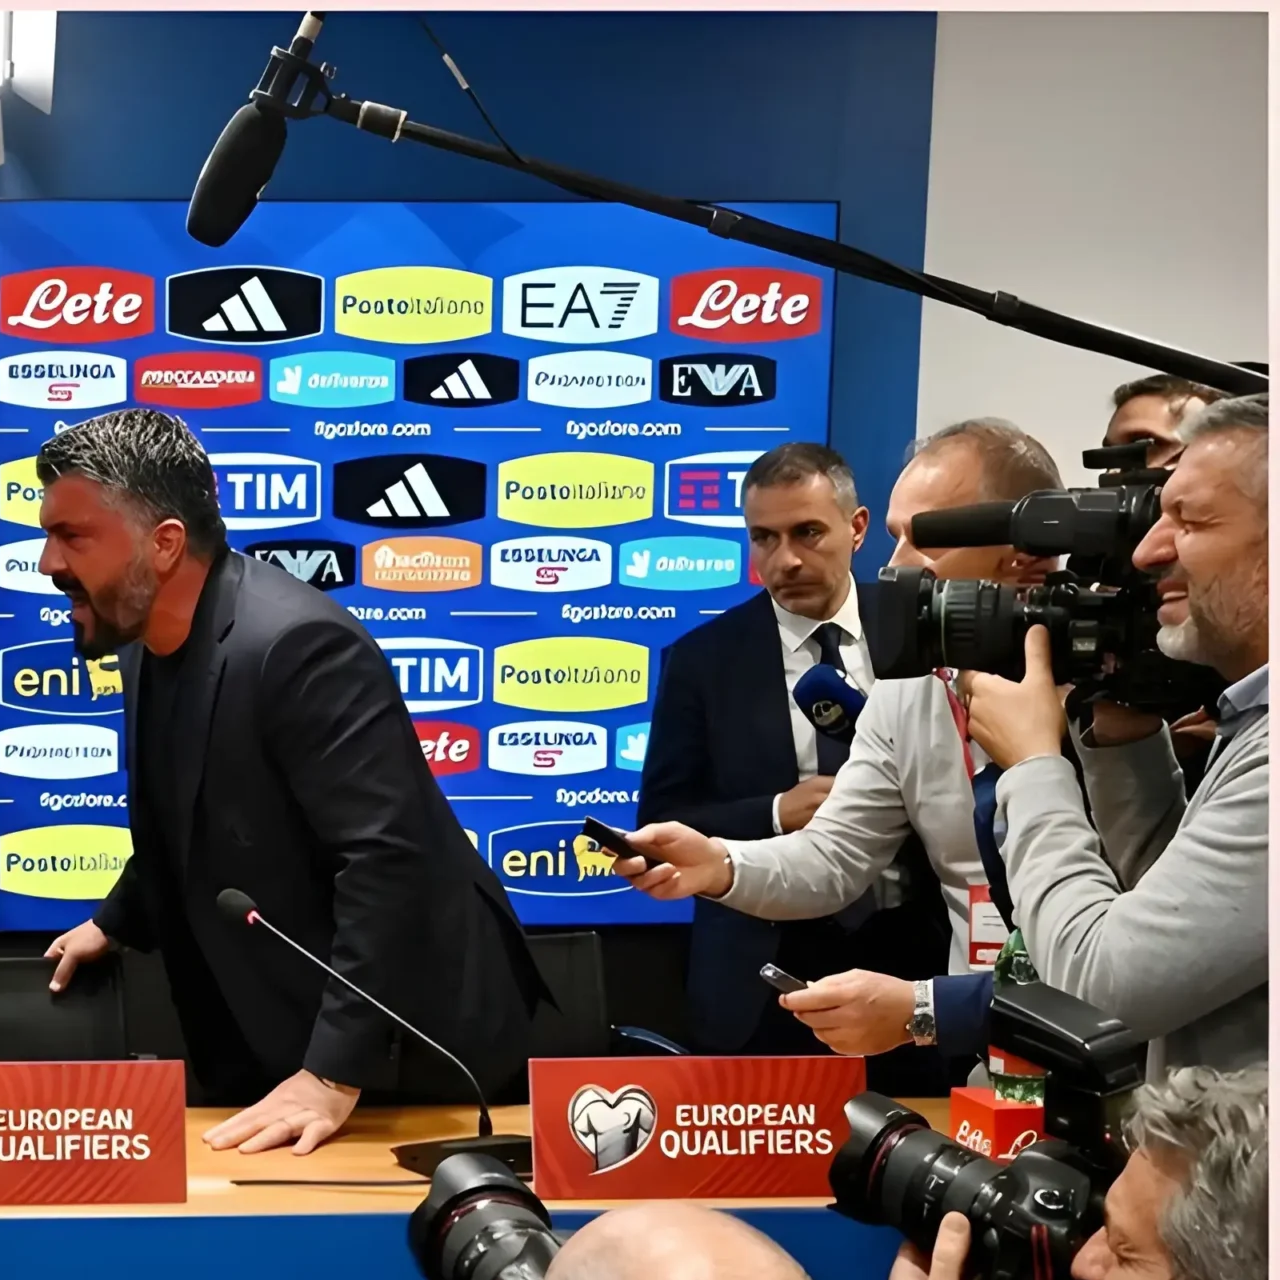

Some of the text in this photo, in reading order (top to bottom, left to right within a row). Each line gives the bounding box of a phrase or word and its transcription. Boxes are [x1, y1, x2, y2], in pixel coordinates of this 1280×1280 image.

[8, 278, 142, 329] Lete
[521, 282, 640, 329] EA7
[678, 280, 809, 330] Lete
[227, 473, 307, 510] TIM
[14, 657, 80, 696] eni
[392, 657, 469, 693] TIM
[502, 838, 566, 878] eni
[675, 1102, 816, 1127] EUROPEAN
[660, 1128, 833, 1157] QUALIFIERS
